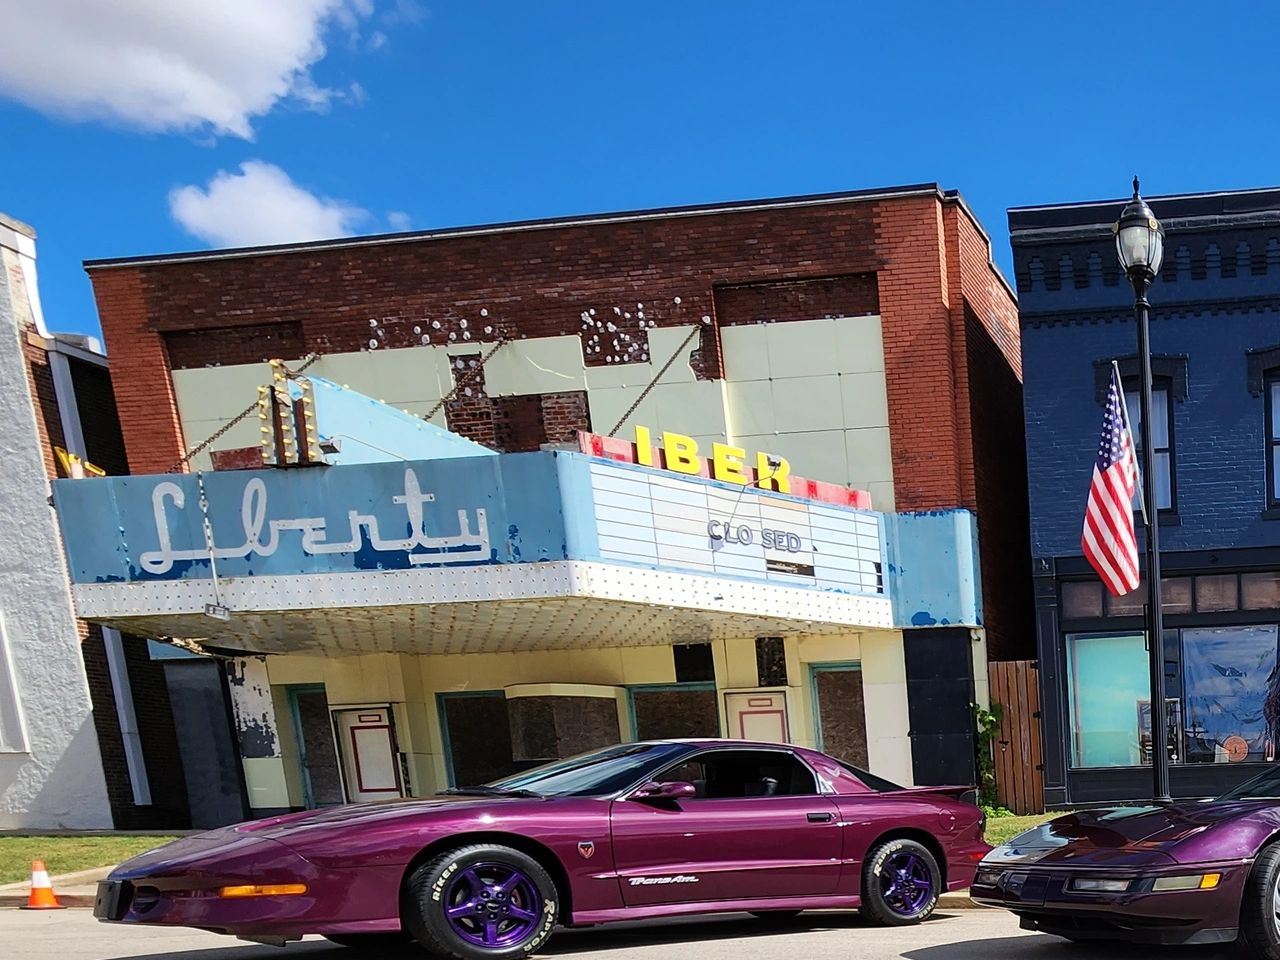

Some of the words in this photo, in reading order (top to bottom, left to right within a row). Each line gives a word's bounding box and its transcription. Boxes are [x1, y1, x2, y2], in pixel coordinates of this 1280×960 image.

[634, 424, 792, 494] IBER
[139, 468, 491, 574] Liberty
[523, 898, 556, 952] RAPTOR
